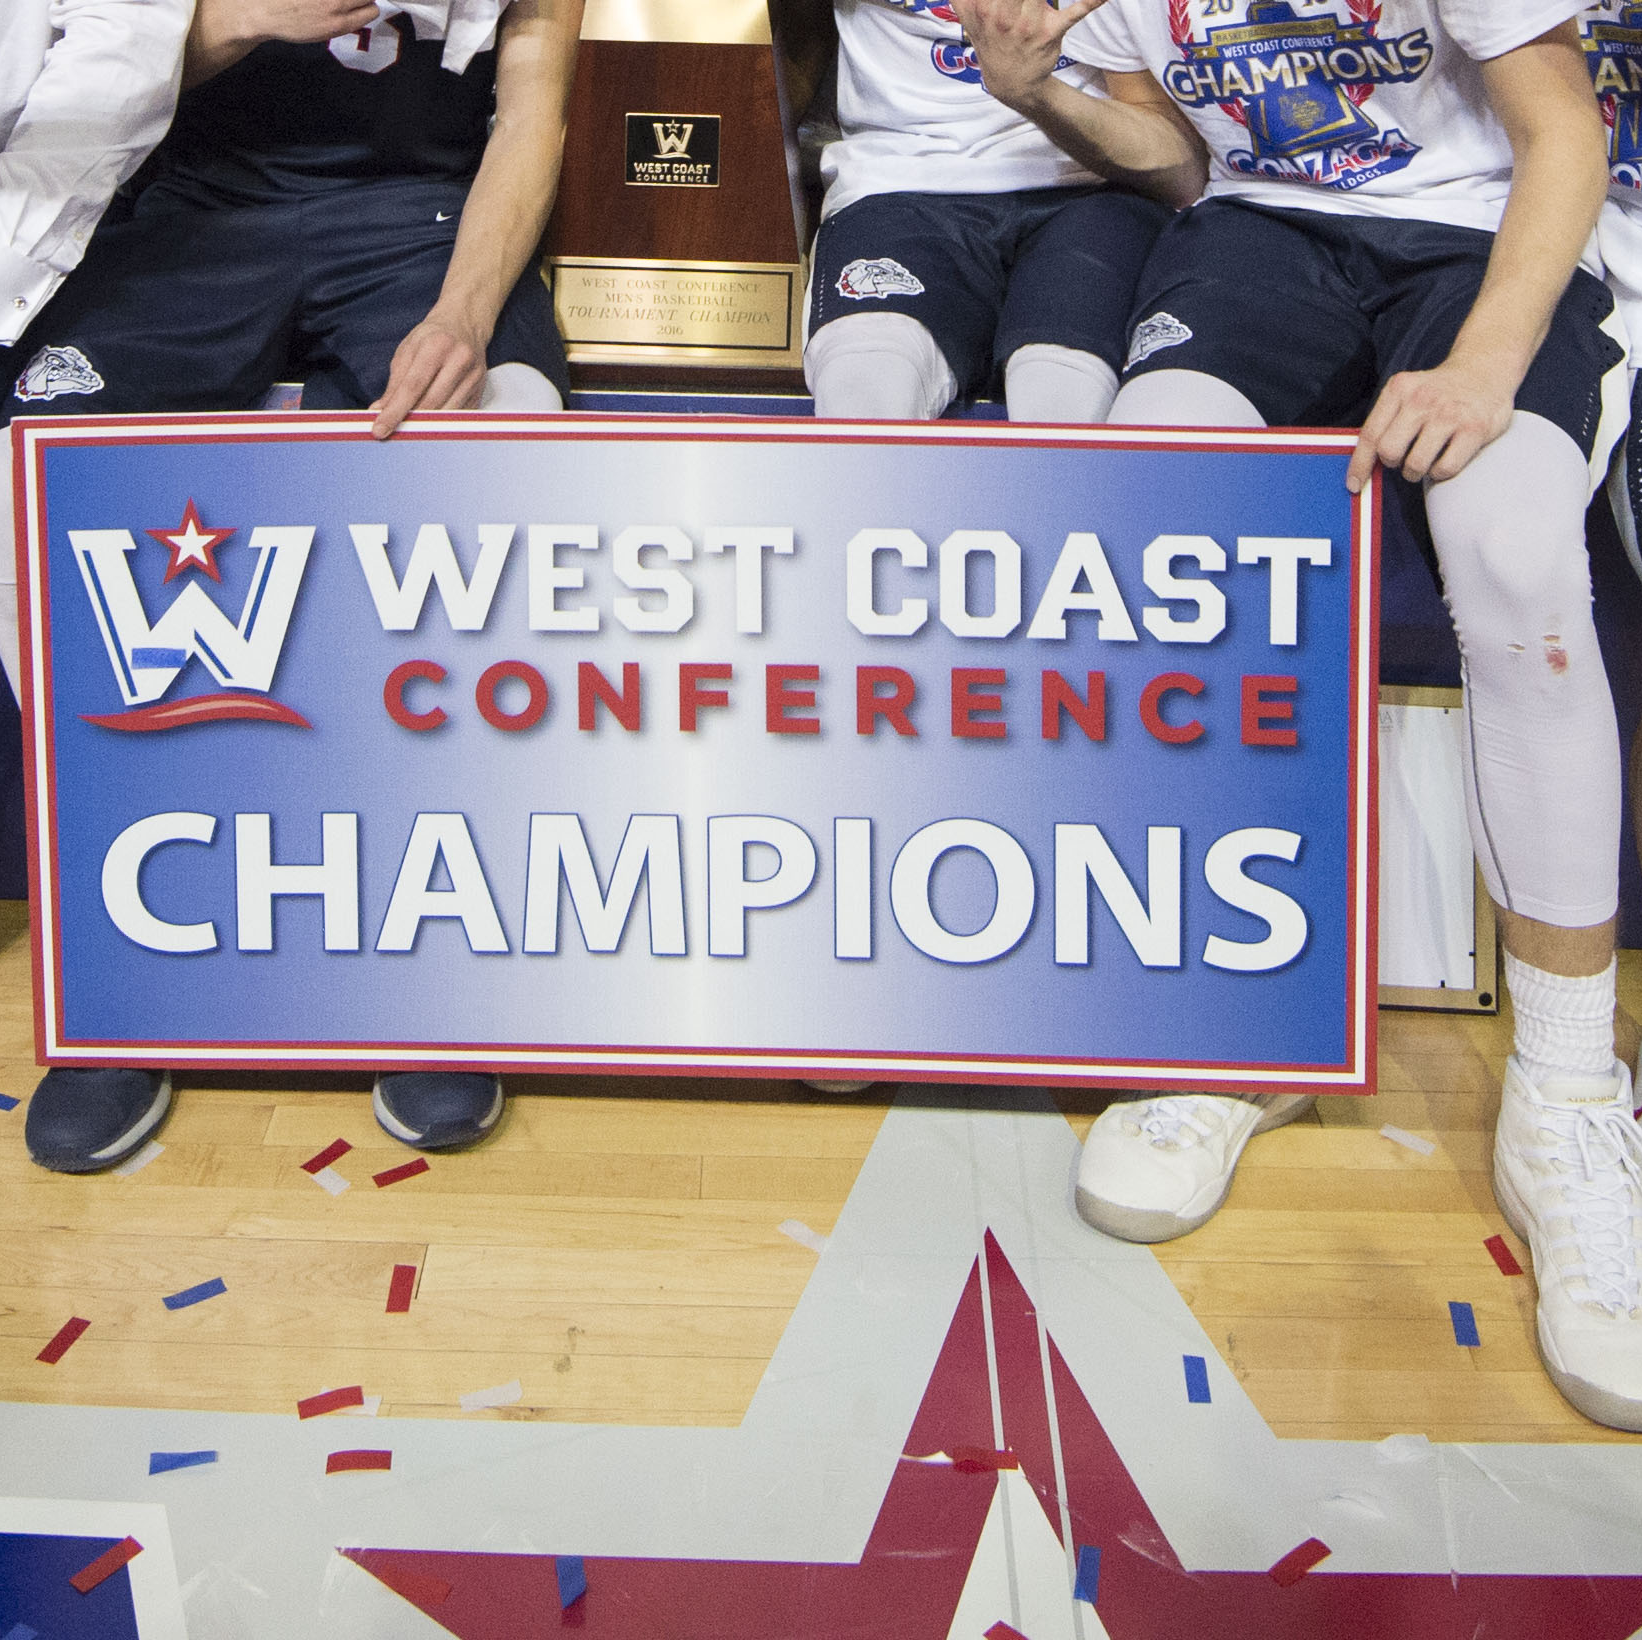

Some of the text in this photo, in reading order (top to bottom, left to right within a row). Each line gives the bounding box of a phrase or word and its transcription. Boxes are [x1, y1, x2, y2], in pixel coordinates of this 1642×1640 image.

[1223, 35, 1334, 58] WEST COAST CONFERENCE
[1166, 33, 1432, 103] CHAMPIONS
[634, 163, 711, 175] WEST COAST
[636, 175, 709, 184] CONFERENCE
[582, 278, 760, 294] WEST COAST CONFERENCE
[653, 295, 737, 306] BASKETBALL
[568, 306, 771, 323] TOURNAMENT CHAMPION
[657, 326, 684, 336] 2016
[348, 523, 1332, 647] WEST COAST
[383, 660, 1299, 748] CONFERENCE
[101, 810, 1310, 973] CHAMPIONS
